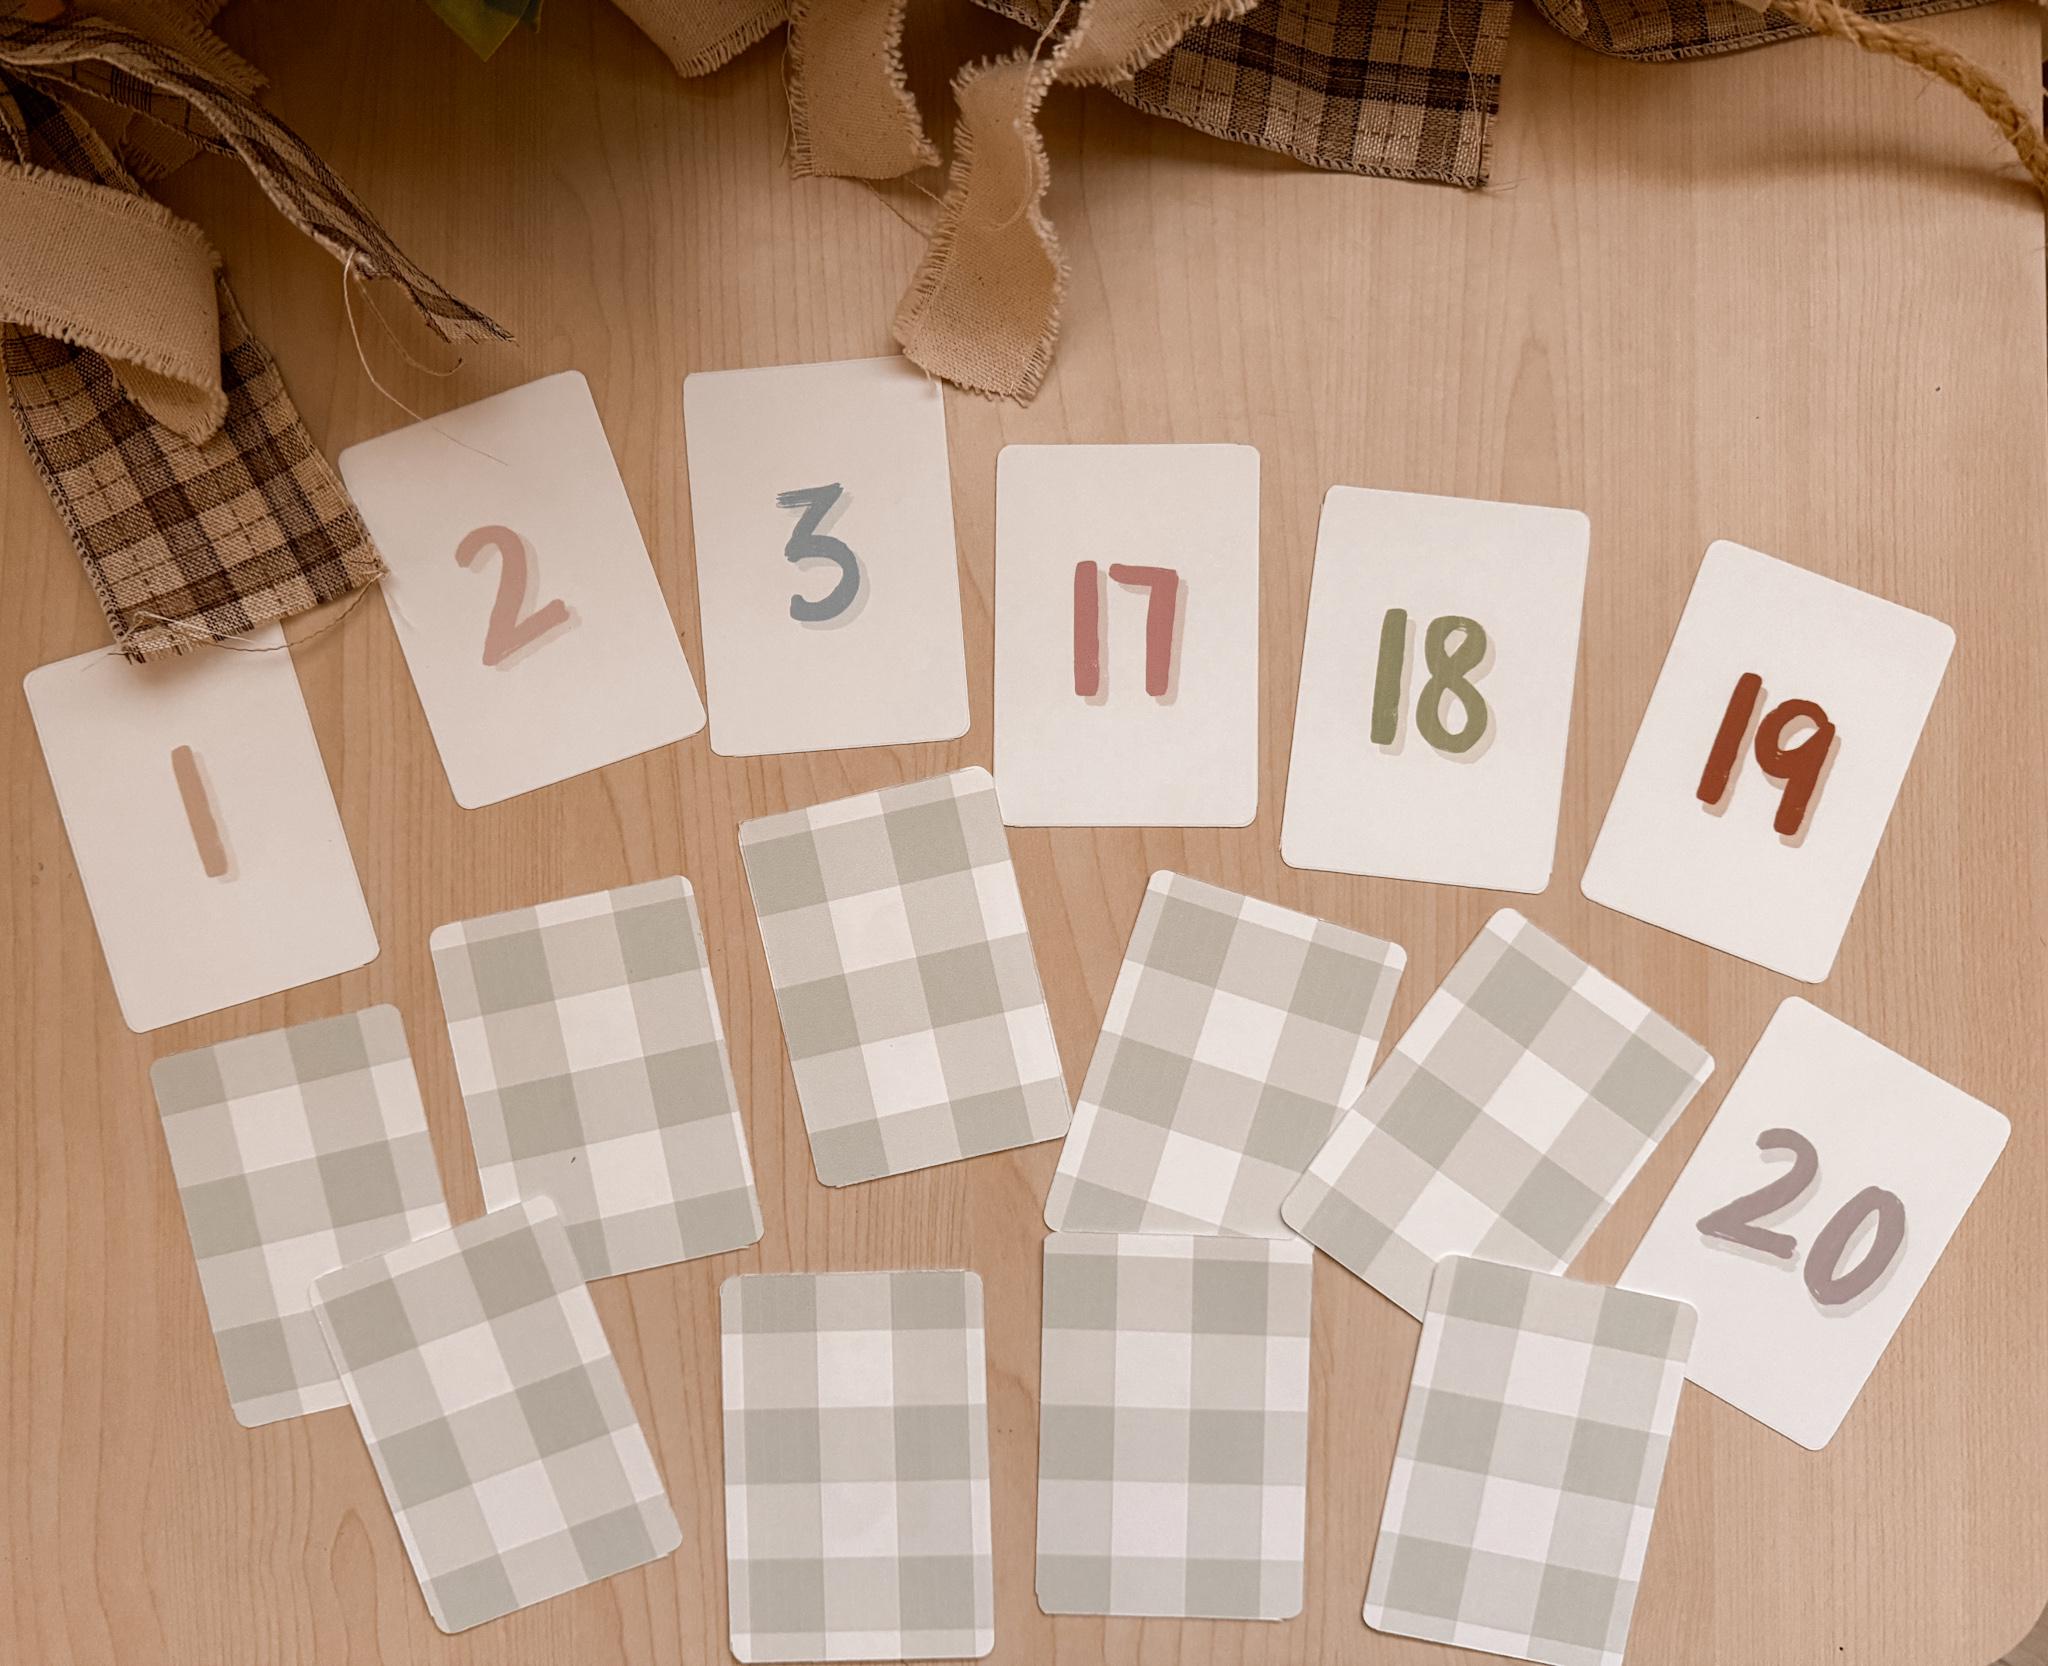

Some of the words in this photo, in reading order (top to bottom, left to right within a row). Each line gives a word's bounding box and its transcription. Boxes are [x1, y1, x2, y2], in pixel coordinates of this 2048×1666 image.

[455, 525, 571, 666] 2
[775, 482, 861, 622] 3
[1073, 560, 1181, 698] 17
[1370, 607, 1489, 755] 18
[171, 744, 230, 878] 1
[1695, 671, 1838, 838] 19
[1696, 1127, 1908, 1306] 20
